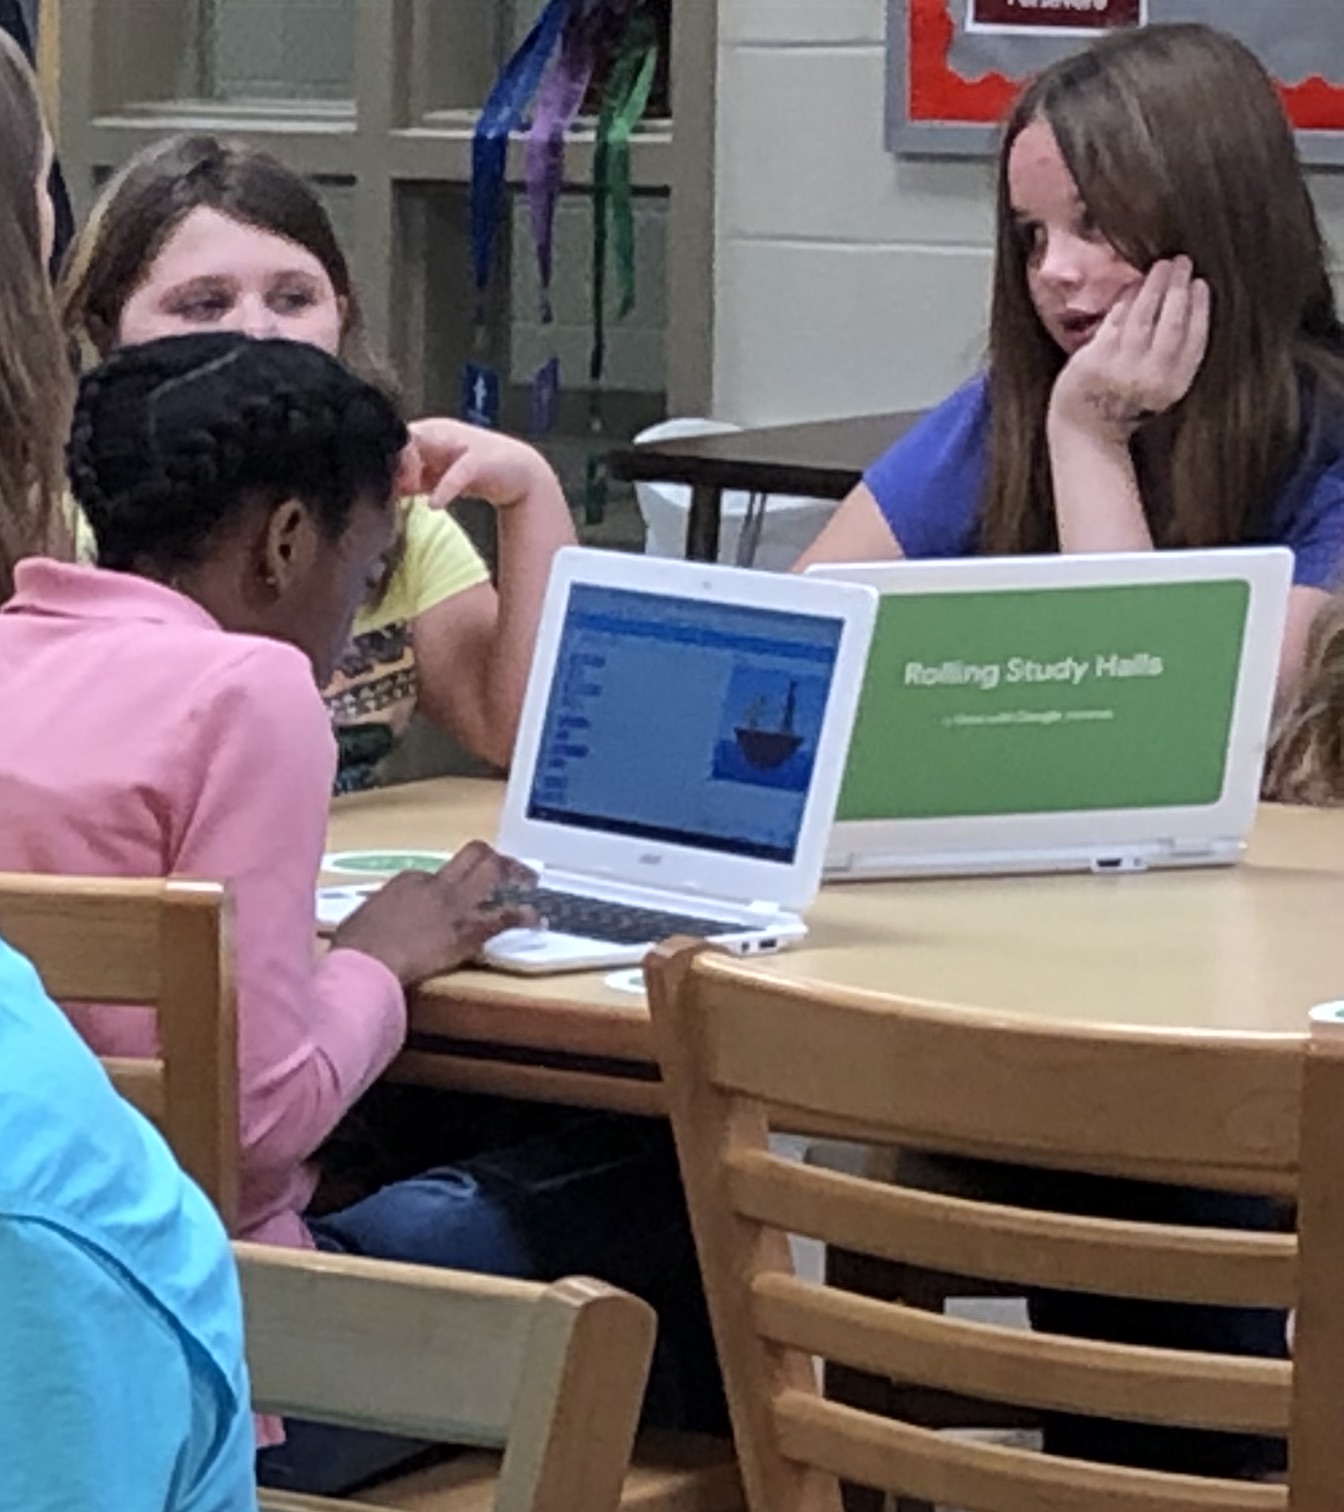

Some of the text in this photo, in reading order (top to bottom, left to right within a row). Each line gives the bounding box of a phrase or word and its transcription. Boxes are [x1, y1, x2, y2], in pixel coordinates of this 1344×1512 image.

[904, 652, 1163, 690] Rolling Study Halls
